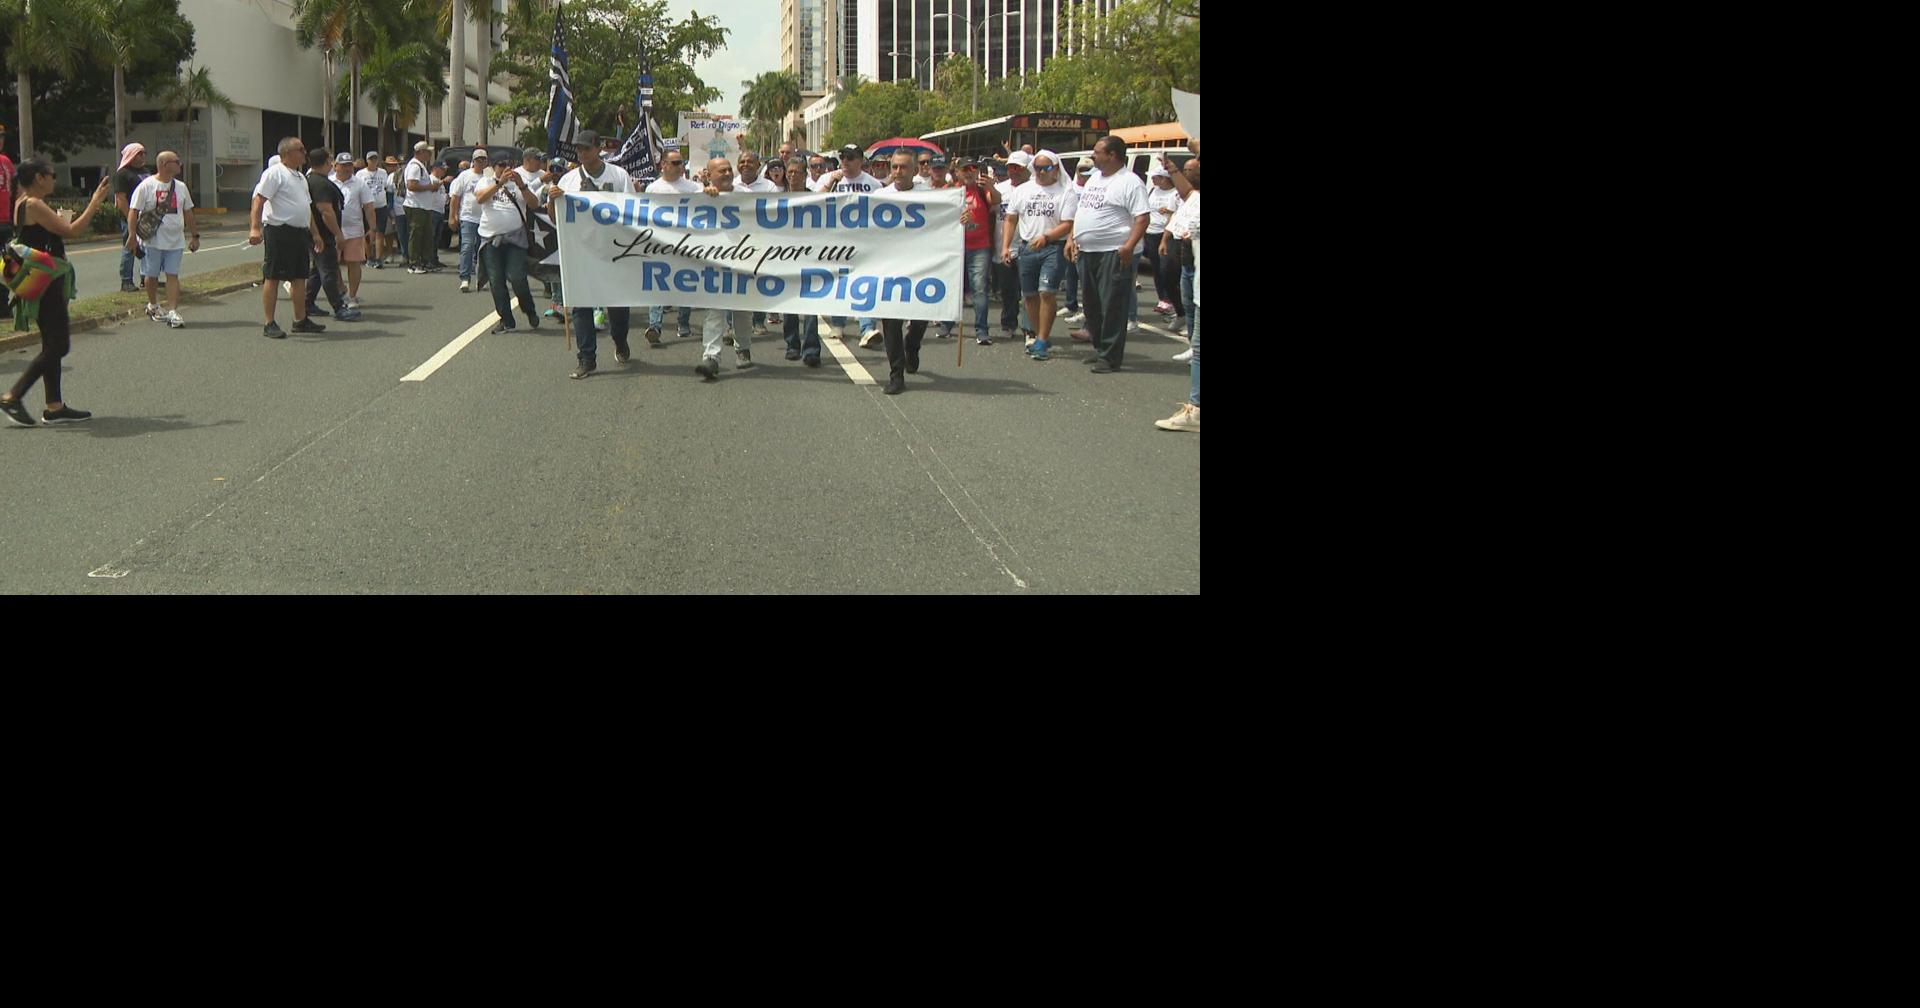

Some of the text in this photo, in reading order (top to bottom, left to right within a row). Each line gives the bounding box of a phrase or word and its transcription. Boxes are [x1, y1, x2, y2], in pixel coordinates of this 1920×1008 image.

[690, 120, 741, 132] Retiro Digno
[1037, 119, 1082, 129] ESCOLAR
[565, 193, 927, 230] Policías Unidos
[612, 228, 858, 276] Luchando por un
[641, 260, 947, 312] Retiro Digno
